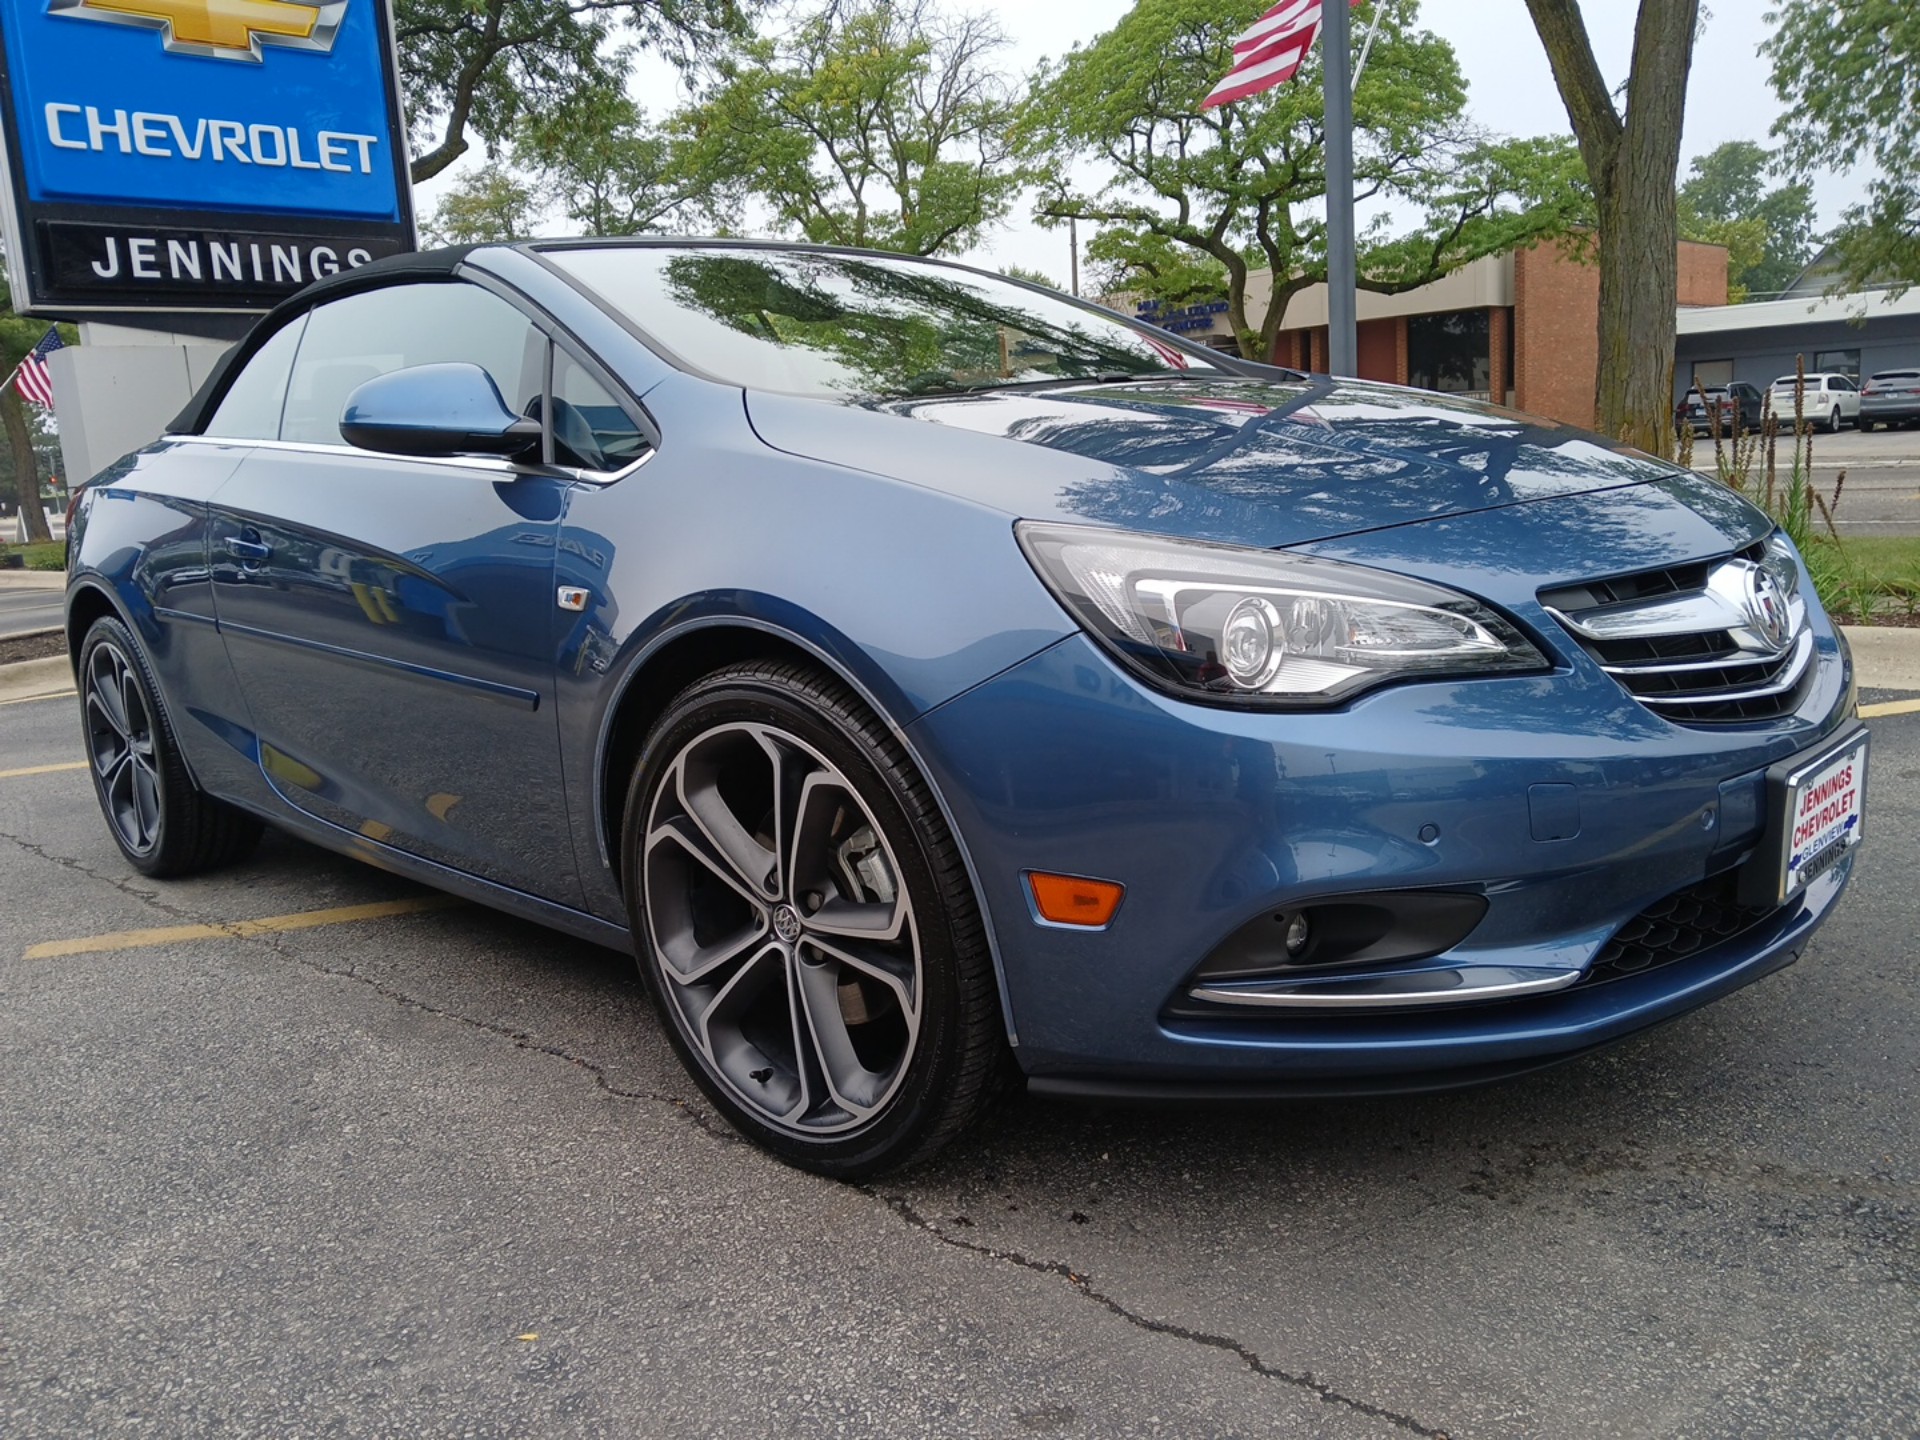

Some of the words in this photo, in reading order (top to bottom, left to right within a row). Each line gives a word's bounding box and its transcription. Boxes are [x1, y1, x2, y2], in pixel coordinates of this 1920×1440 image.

[45, 102, 378, 174] CHEVROLET
[1794, 789, 1856, 849] CHEVROLET
[1800, 765, 1853, 817] JENNINGS
[1802, 823, 1845, 861] GLENVIEW
